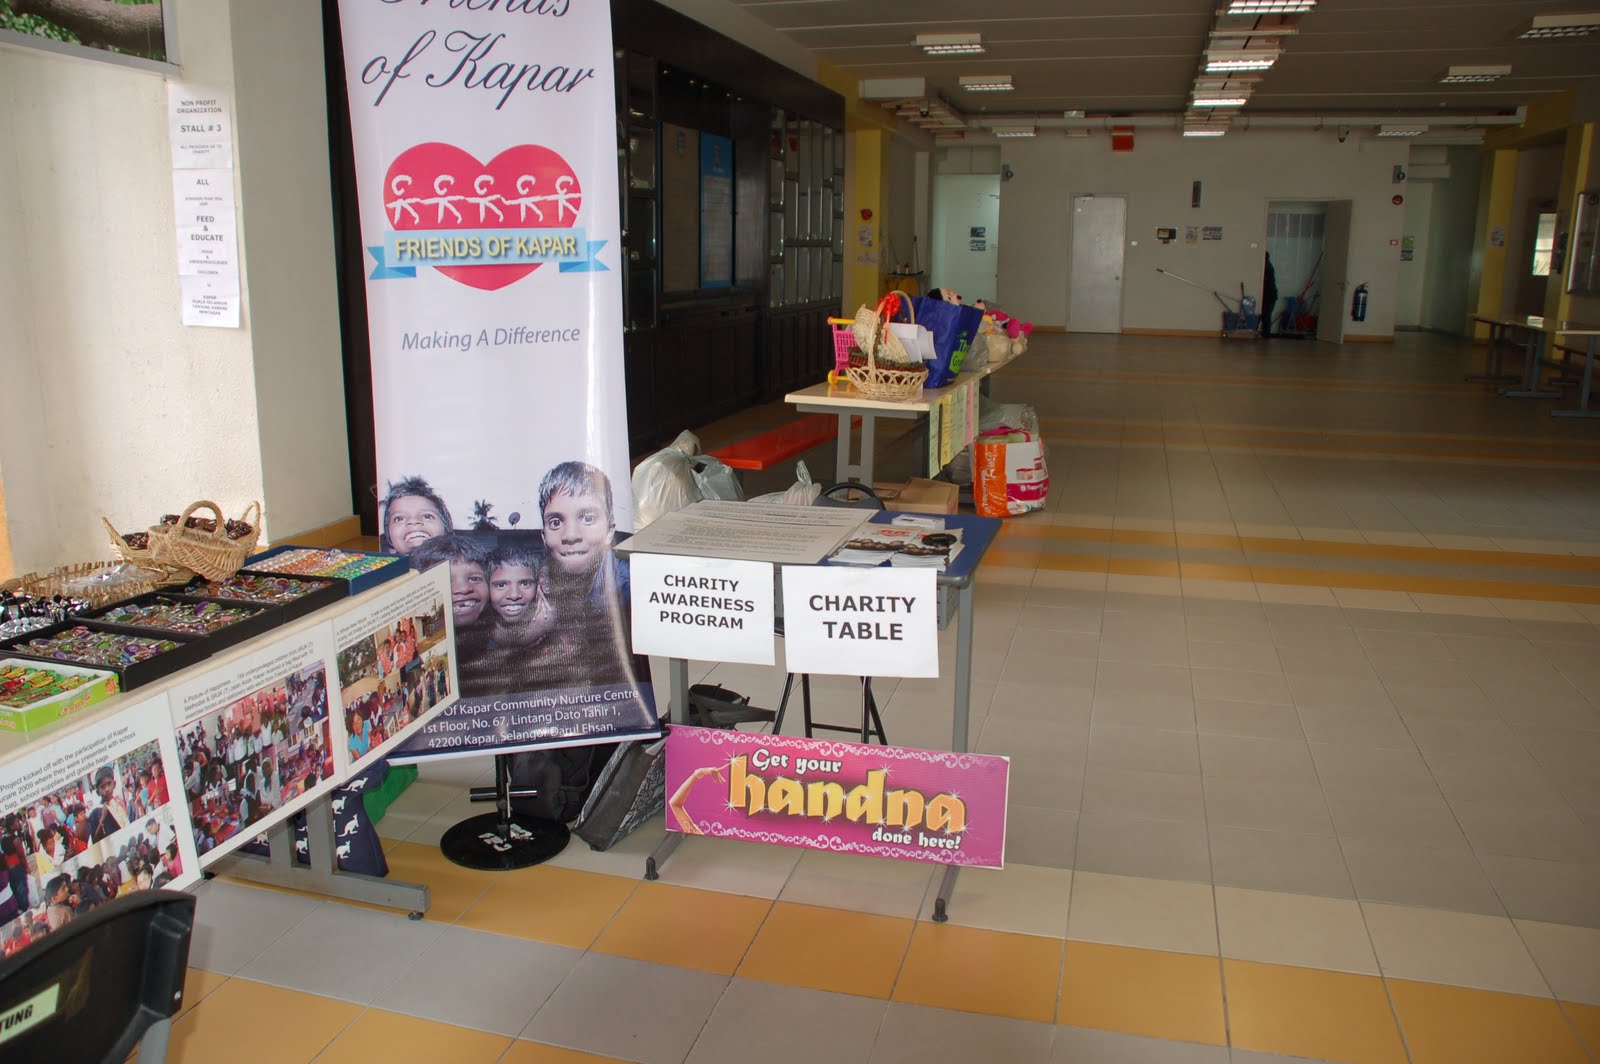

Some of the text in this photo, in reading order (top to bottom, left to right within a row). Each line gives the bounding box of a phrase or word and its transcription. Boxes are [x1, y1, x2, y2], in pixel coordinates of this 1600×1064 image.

[361, 30, 594, 110] of Kapar
[180, 124, 206, 132] STALL
[216, 124, 222, 132] 3
[395, 235, 577, 259] FRIENDS OF KAPAR
[402, 326, 581, 351] Making A Difference
[664, 574, 739, 592] CHARITY
[649, 591, 755, 613] AWARENESS
[808, 594, 917, 614] CHARITY
[659, 610, 744, 630] PROGRAM
[822, 621, 904, 641] TABLE
[444, 690, 639, 716] Of Kapar Community Nurture Centre
[440, 722, 470, 732] Floor,
[472, 719, 490, 729] No.
[492, 716, 509, 727] 67,
[511, 712, 552, 725] Lintang
[555, 711, 580, 721] Dato
[582, 706, 608, 718] Tahir
[612, 706, 620, 716] 1,
[428, 723, 616, 748] 42200 Kapar, Selangor Darul Ehsan.
[0, 726, 129, 792] Project kicked off with the participation of Kapar
[18, 781, 33, 794] 2009
[34, 773, 52, 785] where
[53, 766, 66, 778] they
[67, 760, 80, 771] were
[81, 747, 107, 766] presented
[107, 739, 119, 749] with
[119, 731, 136, 744] school
[752, 748, 843, 775] Get your
[20, 788, 40, 804] school
[40, 778, 65, 793] supplies
[65, 771, 75, 781] and
[76, 762, 95, 776] goodie
[730, 756, 967, 833] handna
[872, 827, 962, 850] done here!
